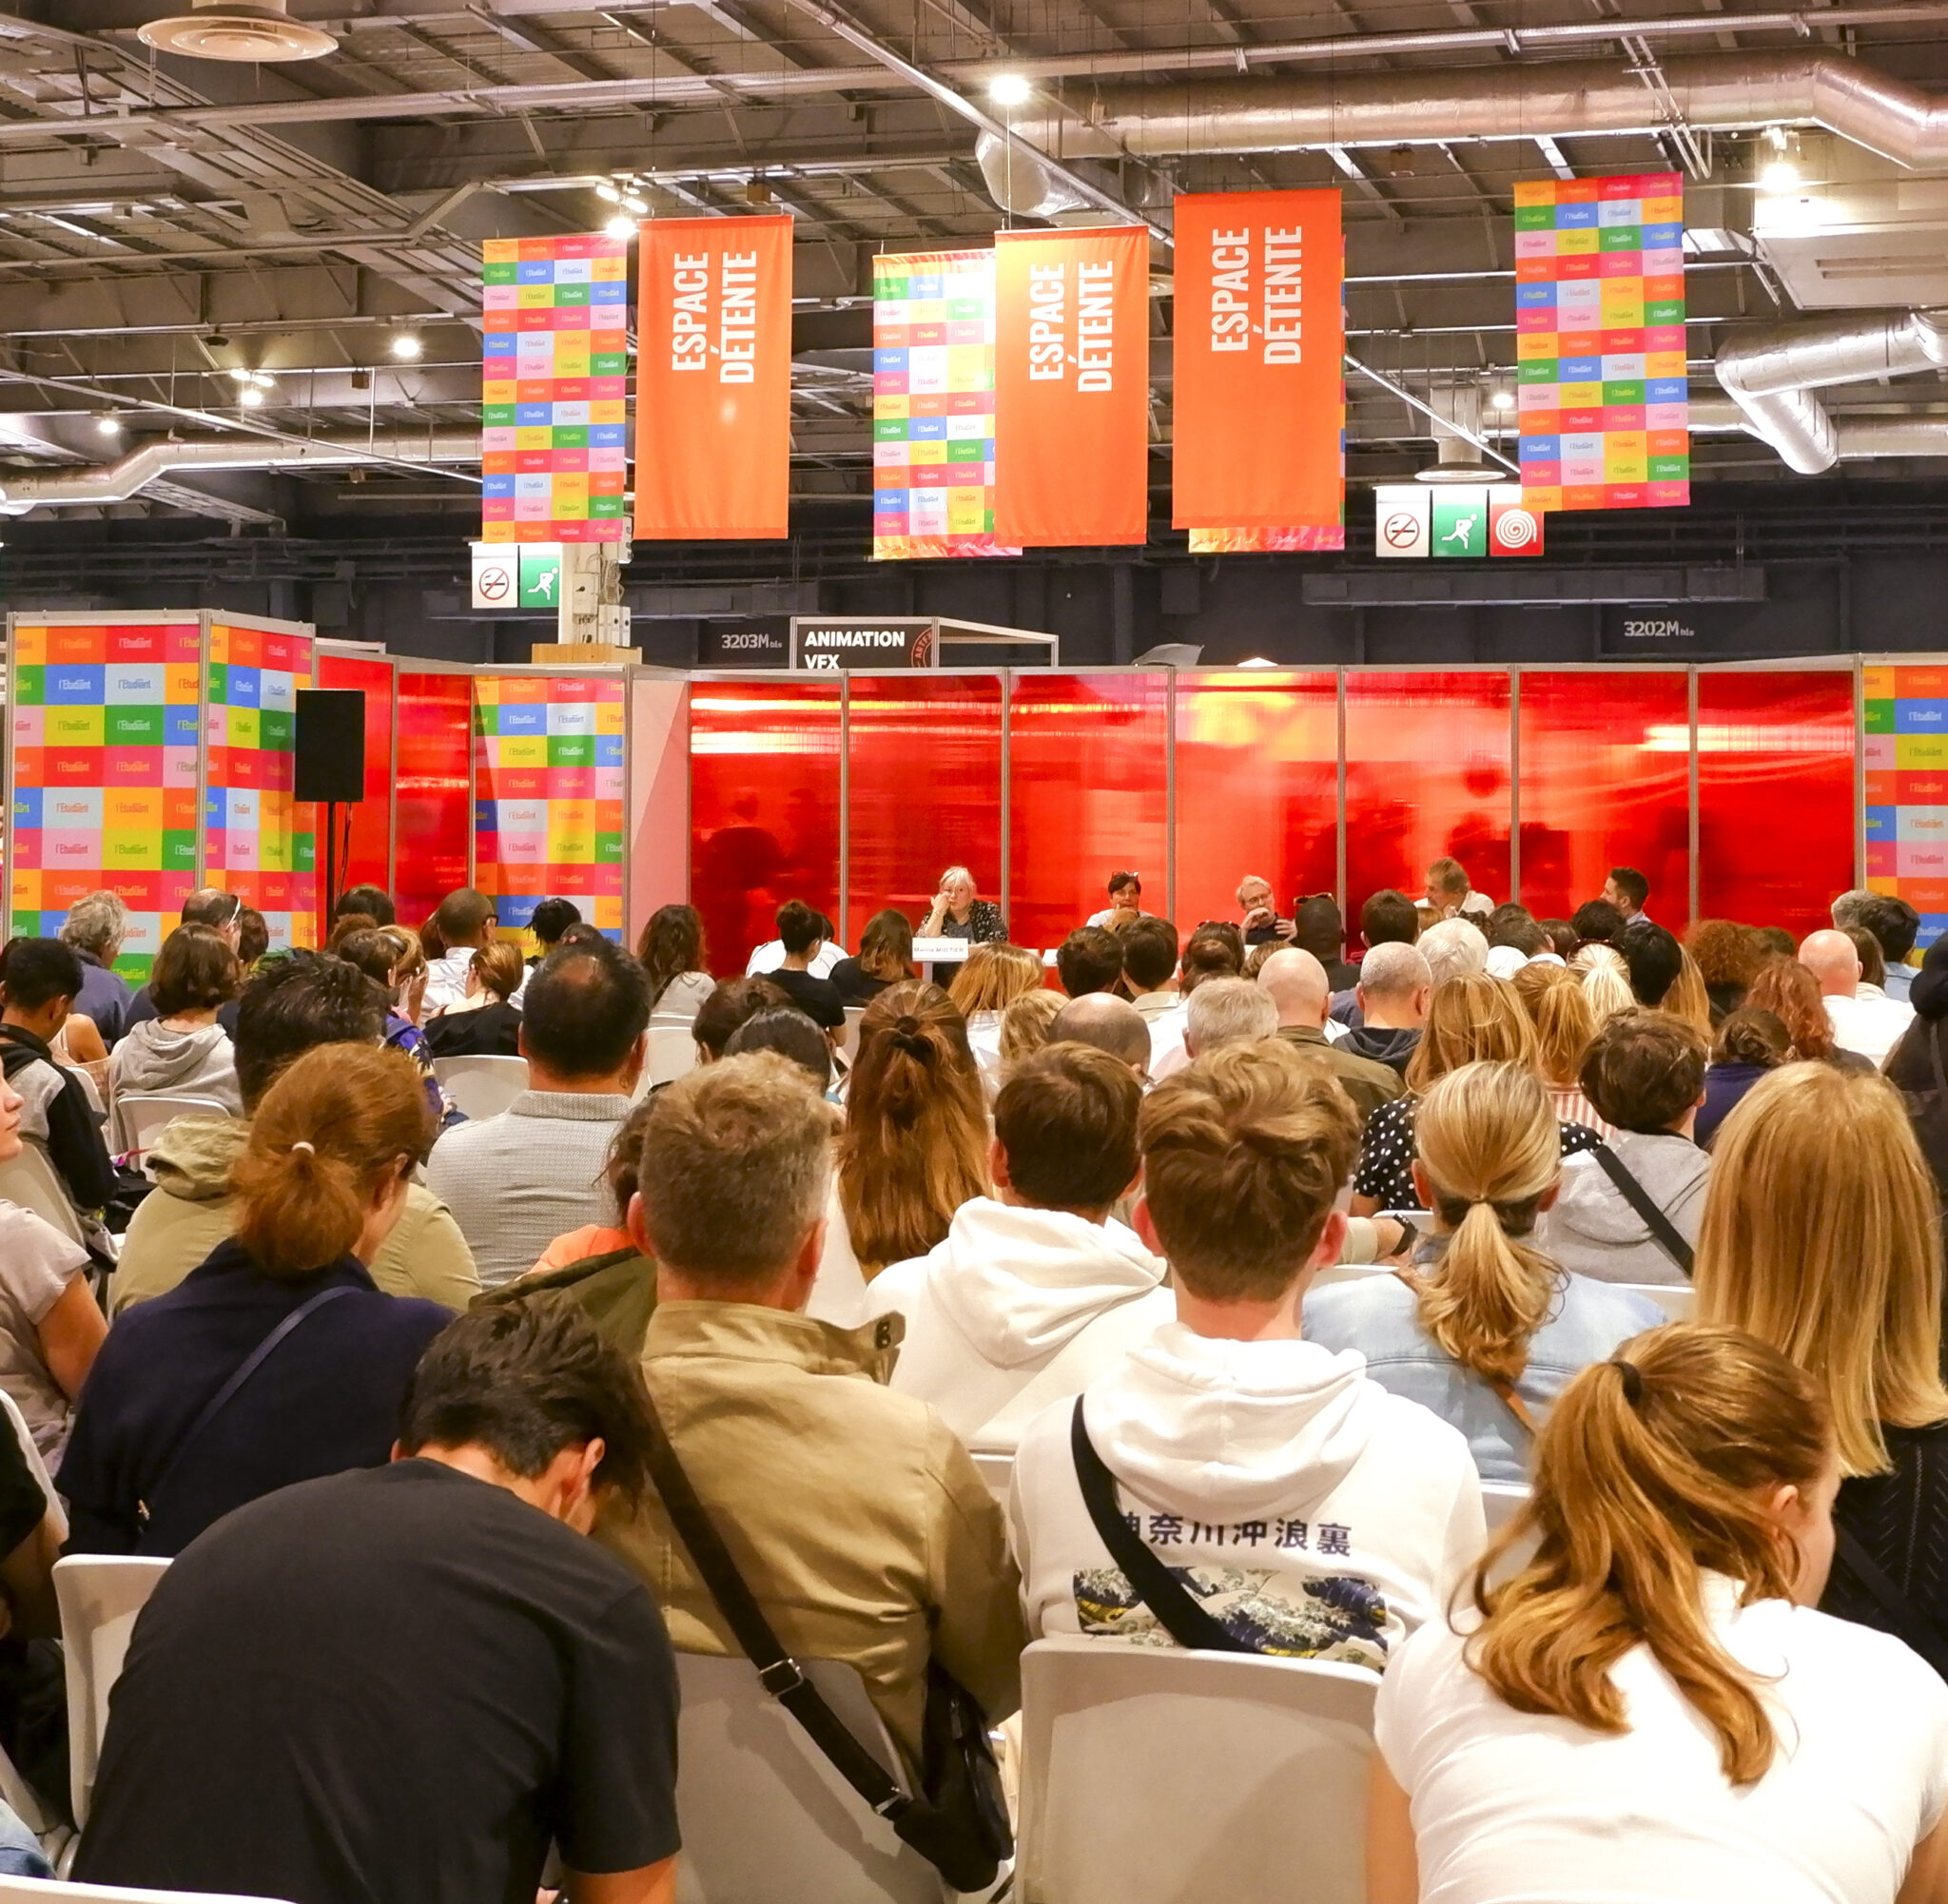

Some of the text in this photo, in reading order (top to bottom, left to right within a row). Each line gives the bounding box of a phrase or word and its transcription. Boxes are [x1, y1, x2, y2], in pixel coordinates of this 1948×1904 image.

[672, 252, 709, 370] ESPACE
[710, 251, 757, 383] DÉTENTE
[1029, 262, 1064, 380] ESPACE
[1067, 261, 1113, 392] DÉTENTE
[1211, 227, 1250, 352] ESPACE
[1252, 225, 1302, 364] DÉTENTE
[804, 654, 840, 670] VFX
[805, 631, 906, 647] ANIMATION
